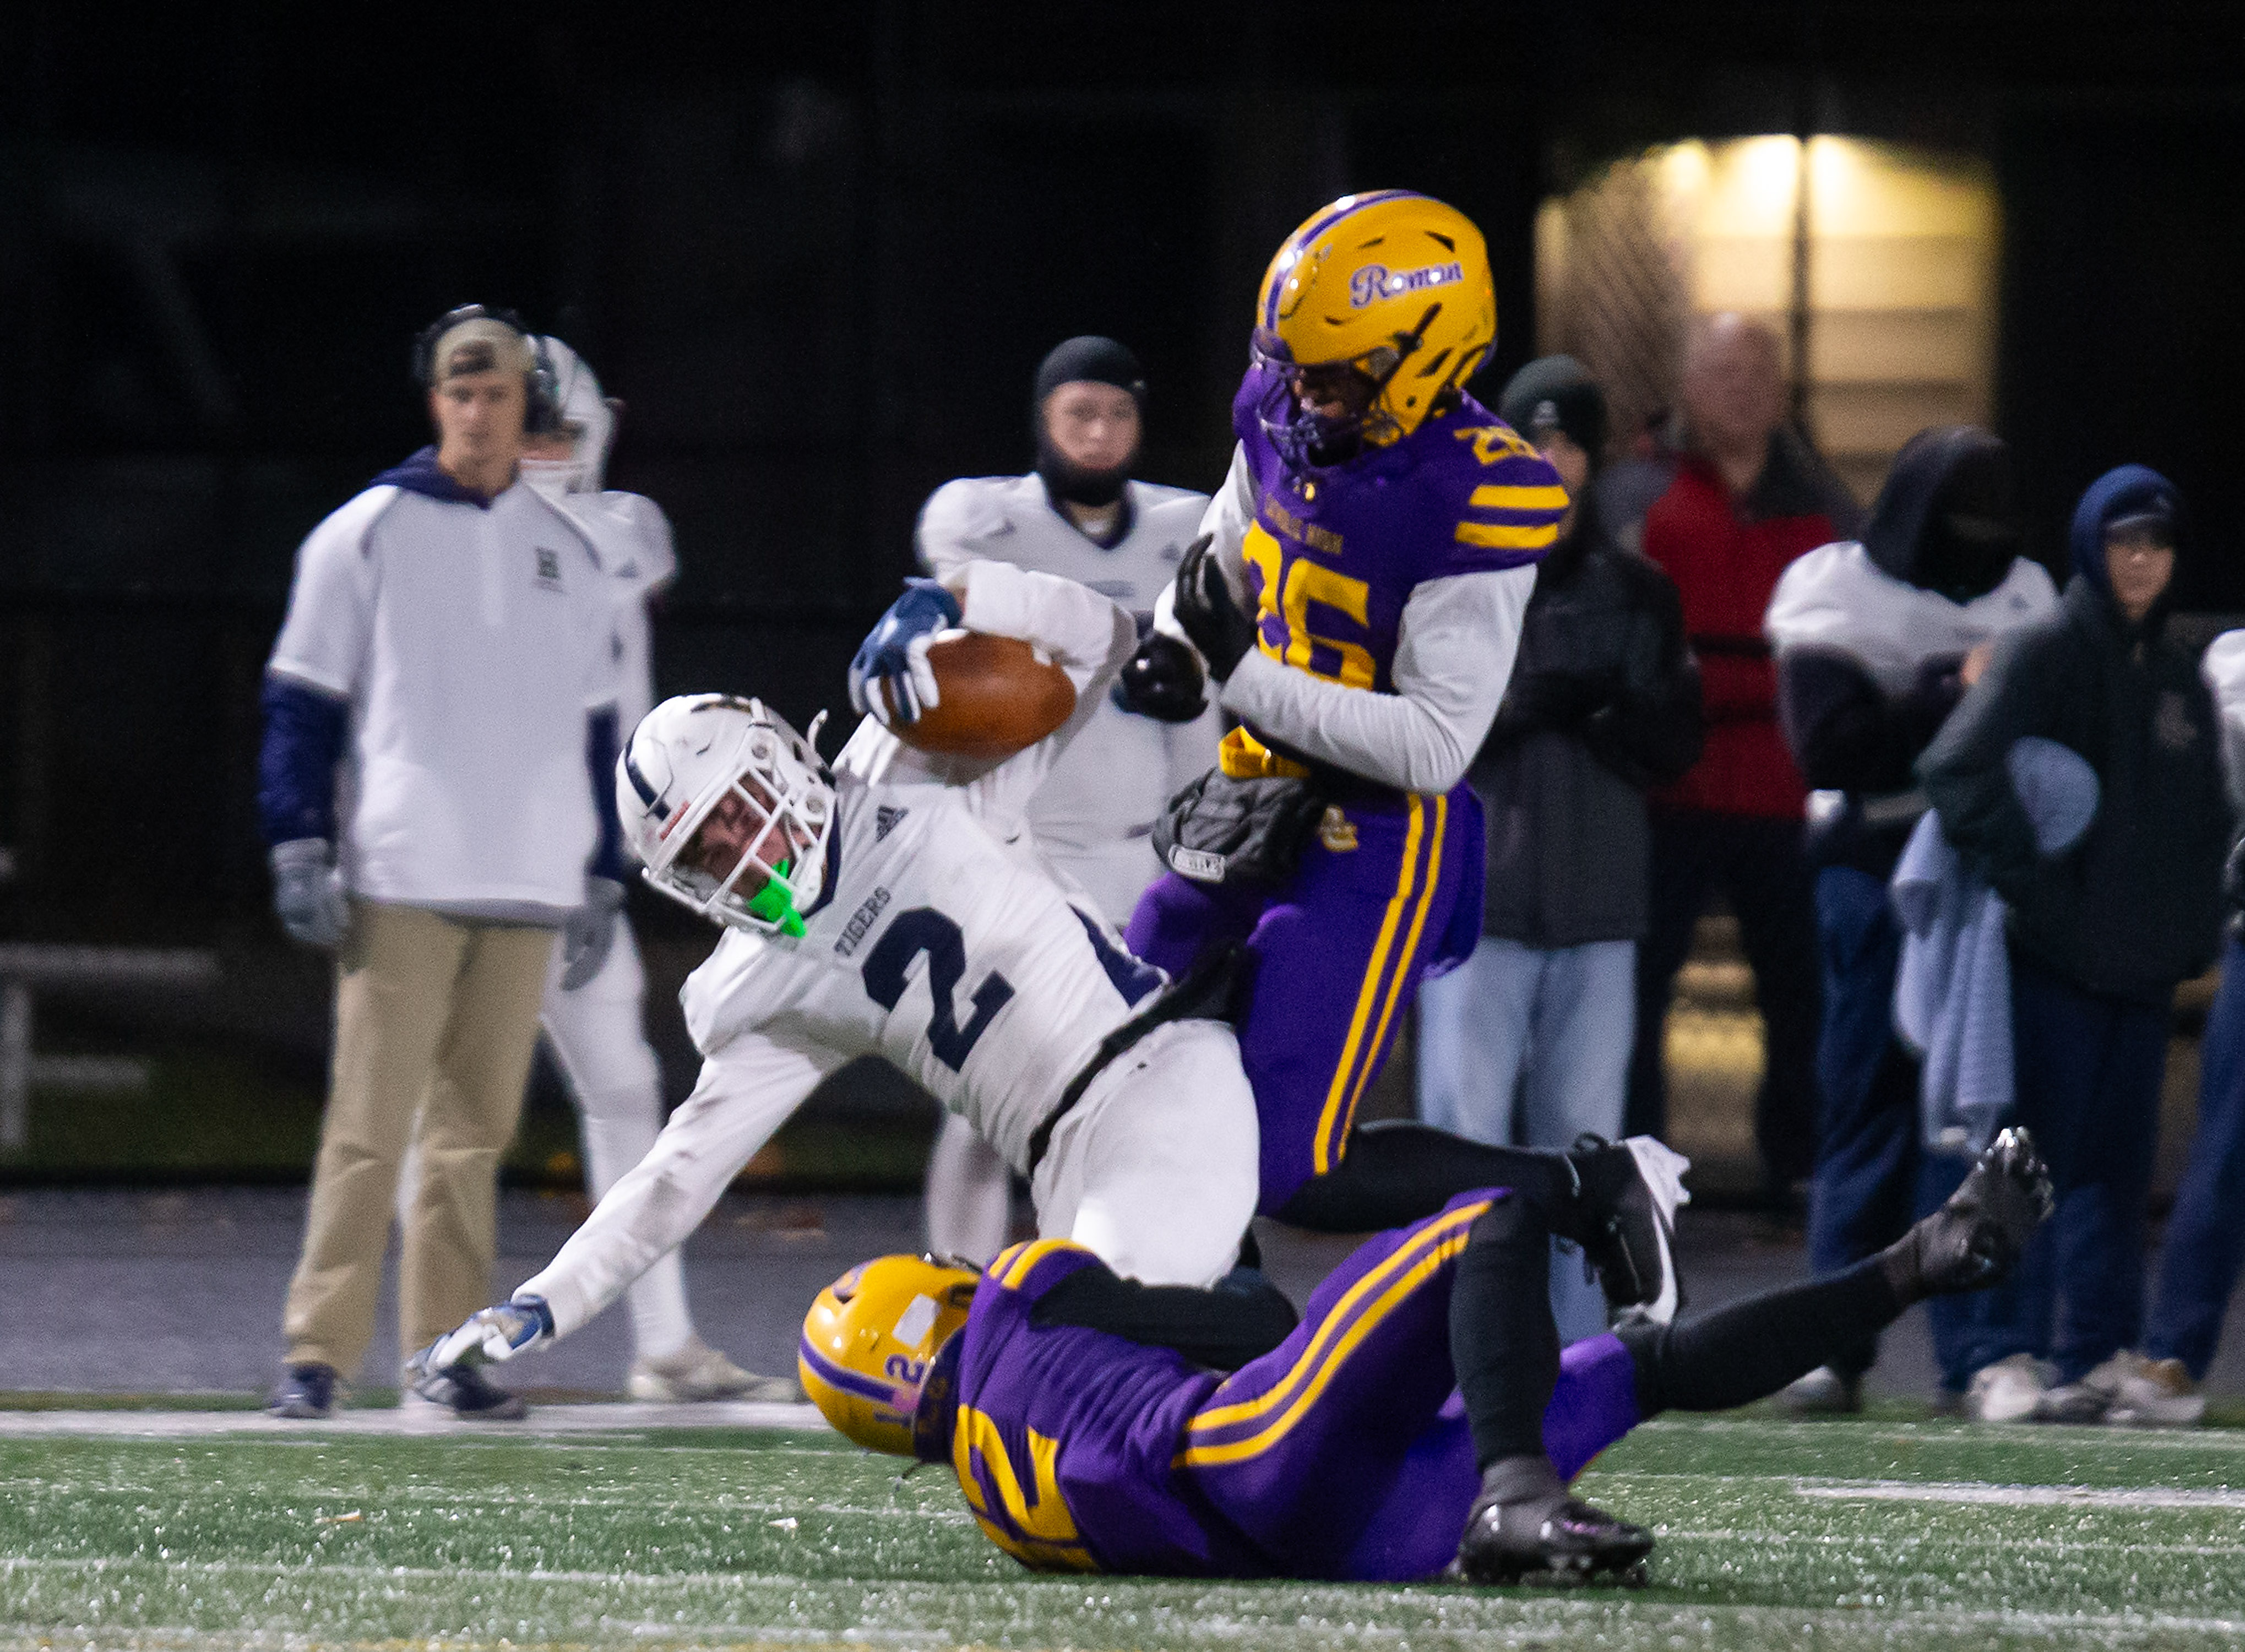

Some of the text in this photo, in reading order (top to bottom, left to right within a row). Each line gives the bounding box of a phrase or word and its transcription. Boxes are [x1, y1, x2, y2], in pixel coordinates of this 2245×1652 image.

[1349, 262, 1465, 309] Roman
[834, 885, 892, 957] TIGERS
[862, 906, 1015, 1073] 2
